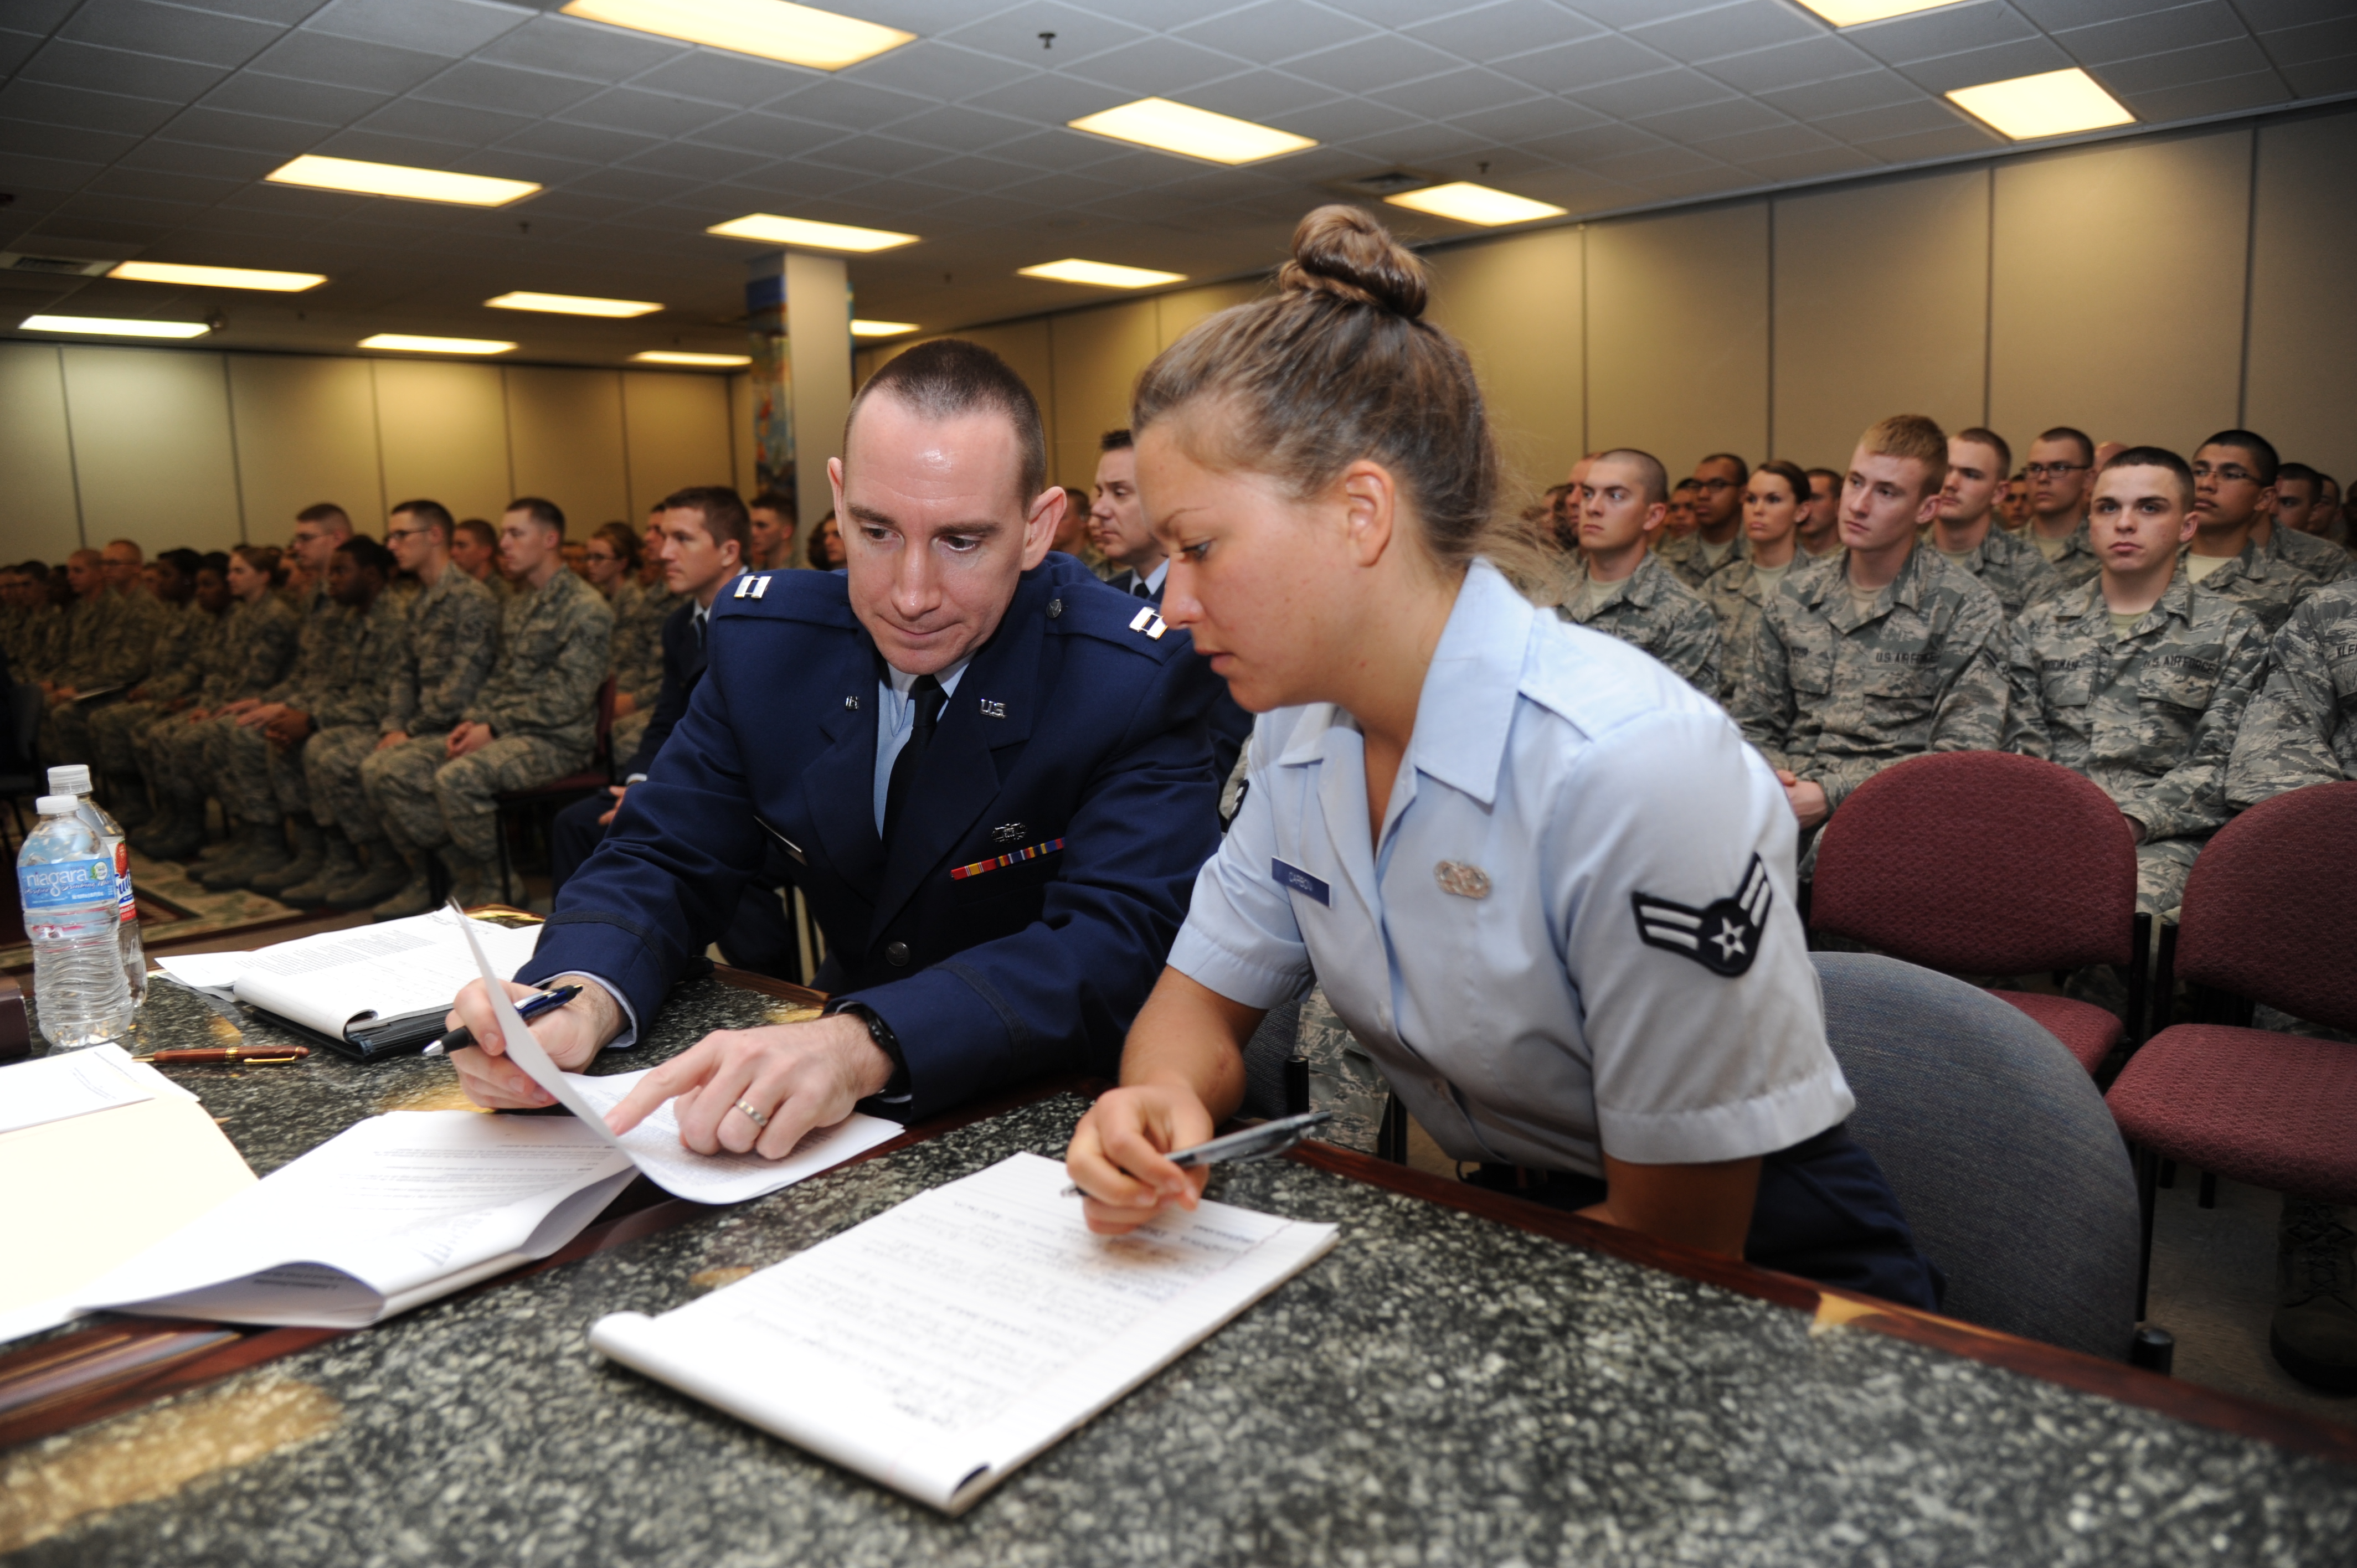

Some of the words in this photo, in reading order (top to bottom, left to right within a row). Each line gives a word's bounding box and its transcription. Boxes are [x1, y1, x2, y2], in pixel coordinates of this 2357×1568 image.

[2163, 656, 2181, 667] AIR
[2183, 656, 2216, 674] FORCE
[27, 868, 89, 897] niagara
